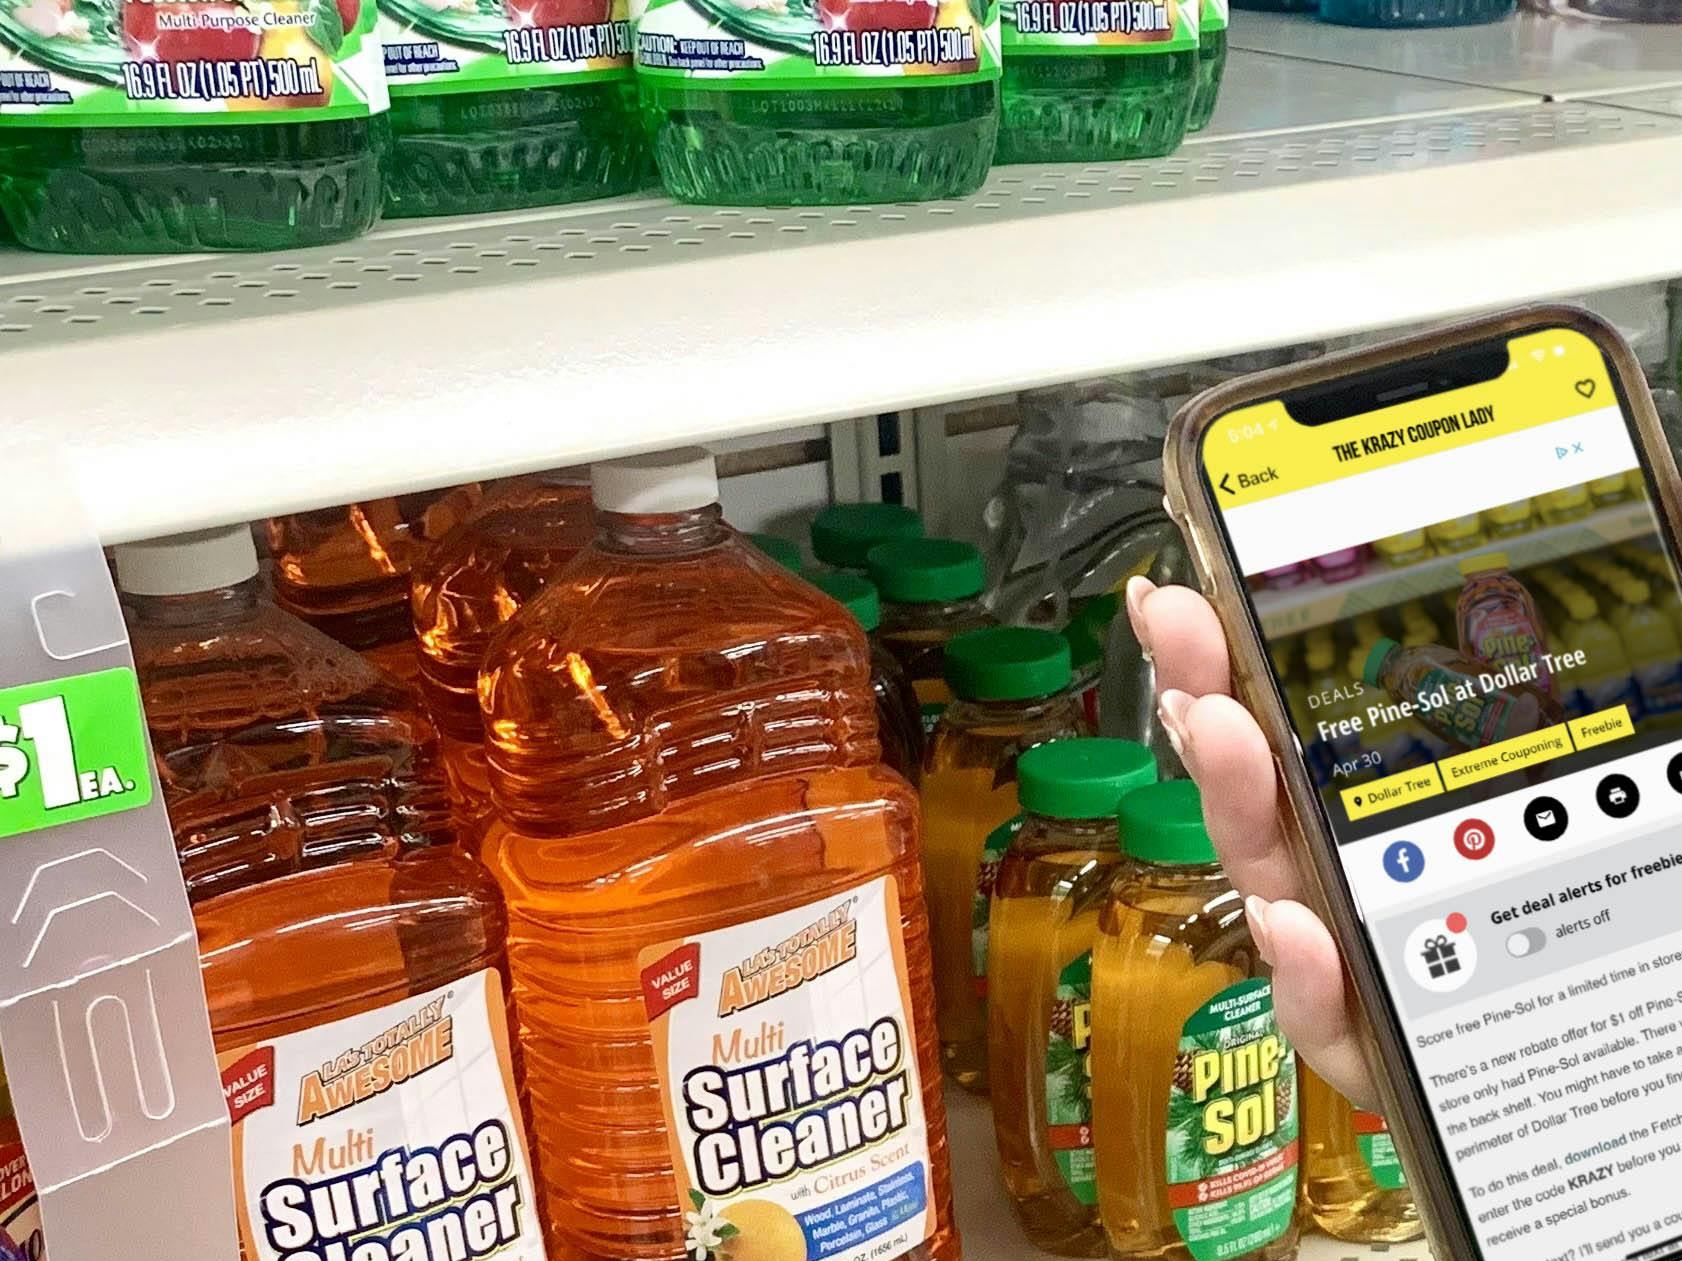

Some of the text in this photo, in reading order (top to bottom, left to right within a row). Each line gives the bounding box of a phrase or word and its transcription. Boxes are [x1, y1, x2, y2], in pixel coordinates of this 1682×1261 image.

[158, 12, 317, 33] Multi Purpose Cleaner
[813, 27, 976, 66] 16.9 FL OZ (1.05 PT) 500 mL
[123, 58, 324, 101] 16.9 FL OZ (1.05 PT) 500 mL
[1330, 403, 1495, 463] THE KRAZY COUPON LADY
[1235, 465, 1280, 489] Back
[1306, 681, 1364, 709] DEALS
[1316, 649, 1586, 742] Free Pine-Sol at Dollar Tree
[1579, 716, 1623, 739] Freebie
[1332, 749, 1382, 777] Apr 30
[1449, 736, 1564, 779] Extreme Couponing
[80, 766, 136, 803] EA.
[1365, 776, 1432, 805] Dollar Tree
[1489, 905, 1520, 925] Get
[1520, 891, 1556, 916] deal
[1557, 879, 1604, 904] alerts
[1603, 870, 1628, 889] for
[776, 900, 852, 960] TOTALLY
[1554, 907, 1611, 939] alerts off
[651, 959, 694, 989] VALUE
[662, 977, 691, 1000] SIZE
[717, 918, 857, 1018] AWESOME
[1209, 984, 1272, 1015] MULTI-SURFACE
[1224, 1001, 1262, 1022] CLEANER
[1414, 1027, 1454, 1049] Score
[1454, 1018, 1482, 1036] free
[1480, 996, 1537, 1027] Pine-Sol
[1535, 992, 1555, 1008] for
[1556, 989, 1568, 1002] a
[1565, 972, 1609, 998] limited
[1607, 966, 1637, 984] time
[1635, 960, 1652, 974] in
[360, 994, 446, 1062] TOTALLY
[712, 1021, 785, 1065] Multi
[1427, 1063, 1478, 1089] There's
[1478, 1059, 1490, 1073] a
[1489, 1049, 1517, 1069] new
[1517, 1035, 1560, 1059] rebate
[1559, 1024, 1589, 1044] offer
[1588, 1018, 1608, 1034] for
[1608, 1010, 1626, 1028] $1
[1626, 1003, 1645, 1021] off
[223, 1064, 269, 1098] VALUE
[297, 1015, 453, 1126] AWESOME
[684, 1018, 901, 1132] Surface
[1193, 1034, 1288, 1104] Pine-
[234, 1084, 266, 1110] SIZE
[1203, 1080, 1278, 1156] Sol
[291, 1128, 374, 1177] Multi
[694, 1070, 908, 1196] Cleaner
[262, 1120, 512, 1250] Surface
[790, 1143, 910, 1201] with Citrus Scent
